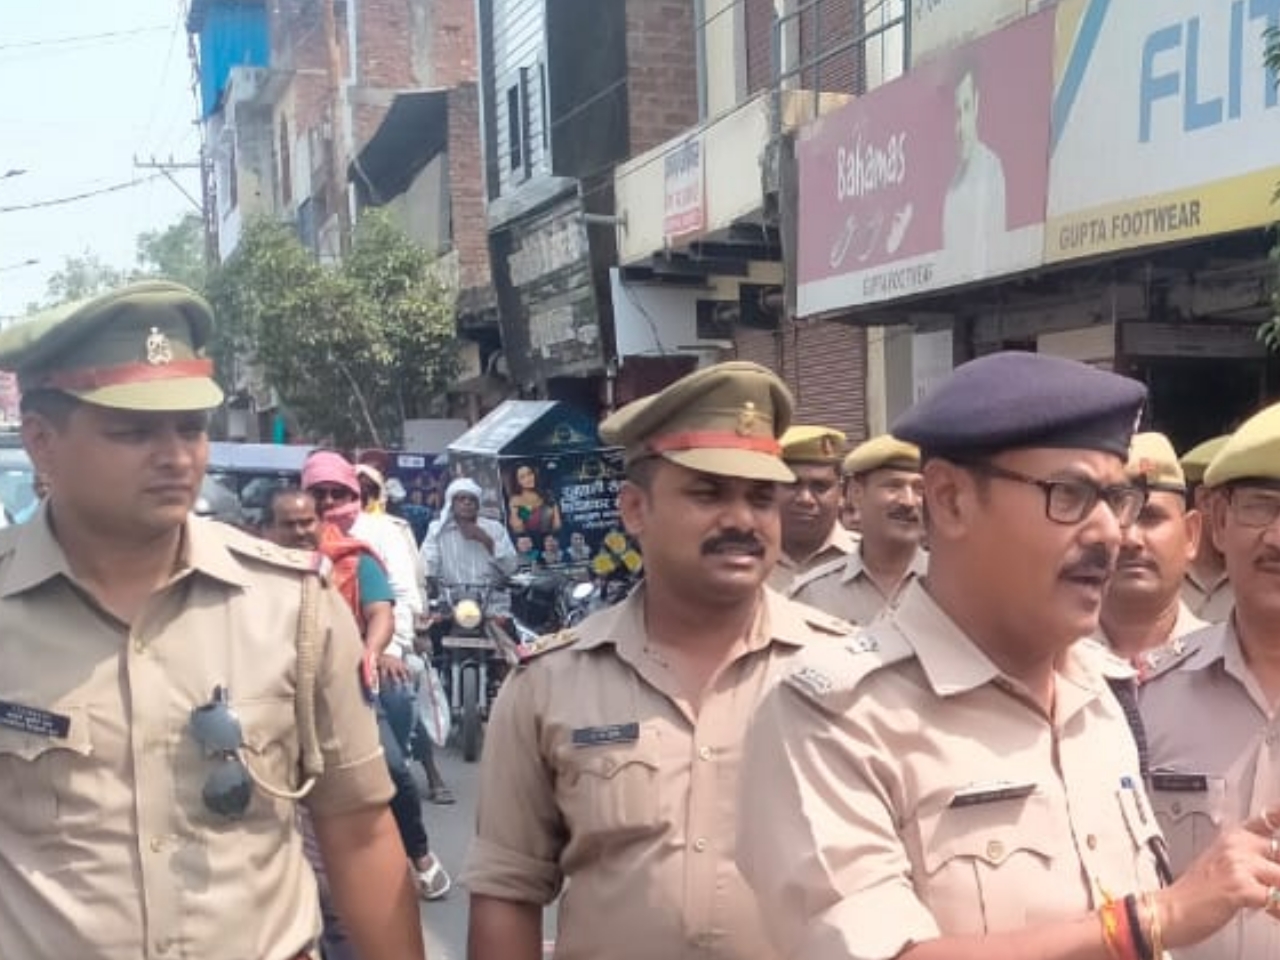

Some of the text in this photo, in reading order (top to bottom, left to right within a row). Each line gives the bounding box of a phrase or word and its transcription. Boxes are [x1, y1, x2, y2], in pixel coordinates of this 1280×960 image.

[837, 132, 906, 200] Bahamas
[1059, 200, 1201, 250] GUPTA FOOTWEAR
